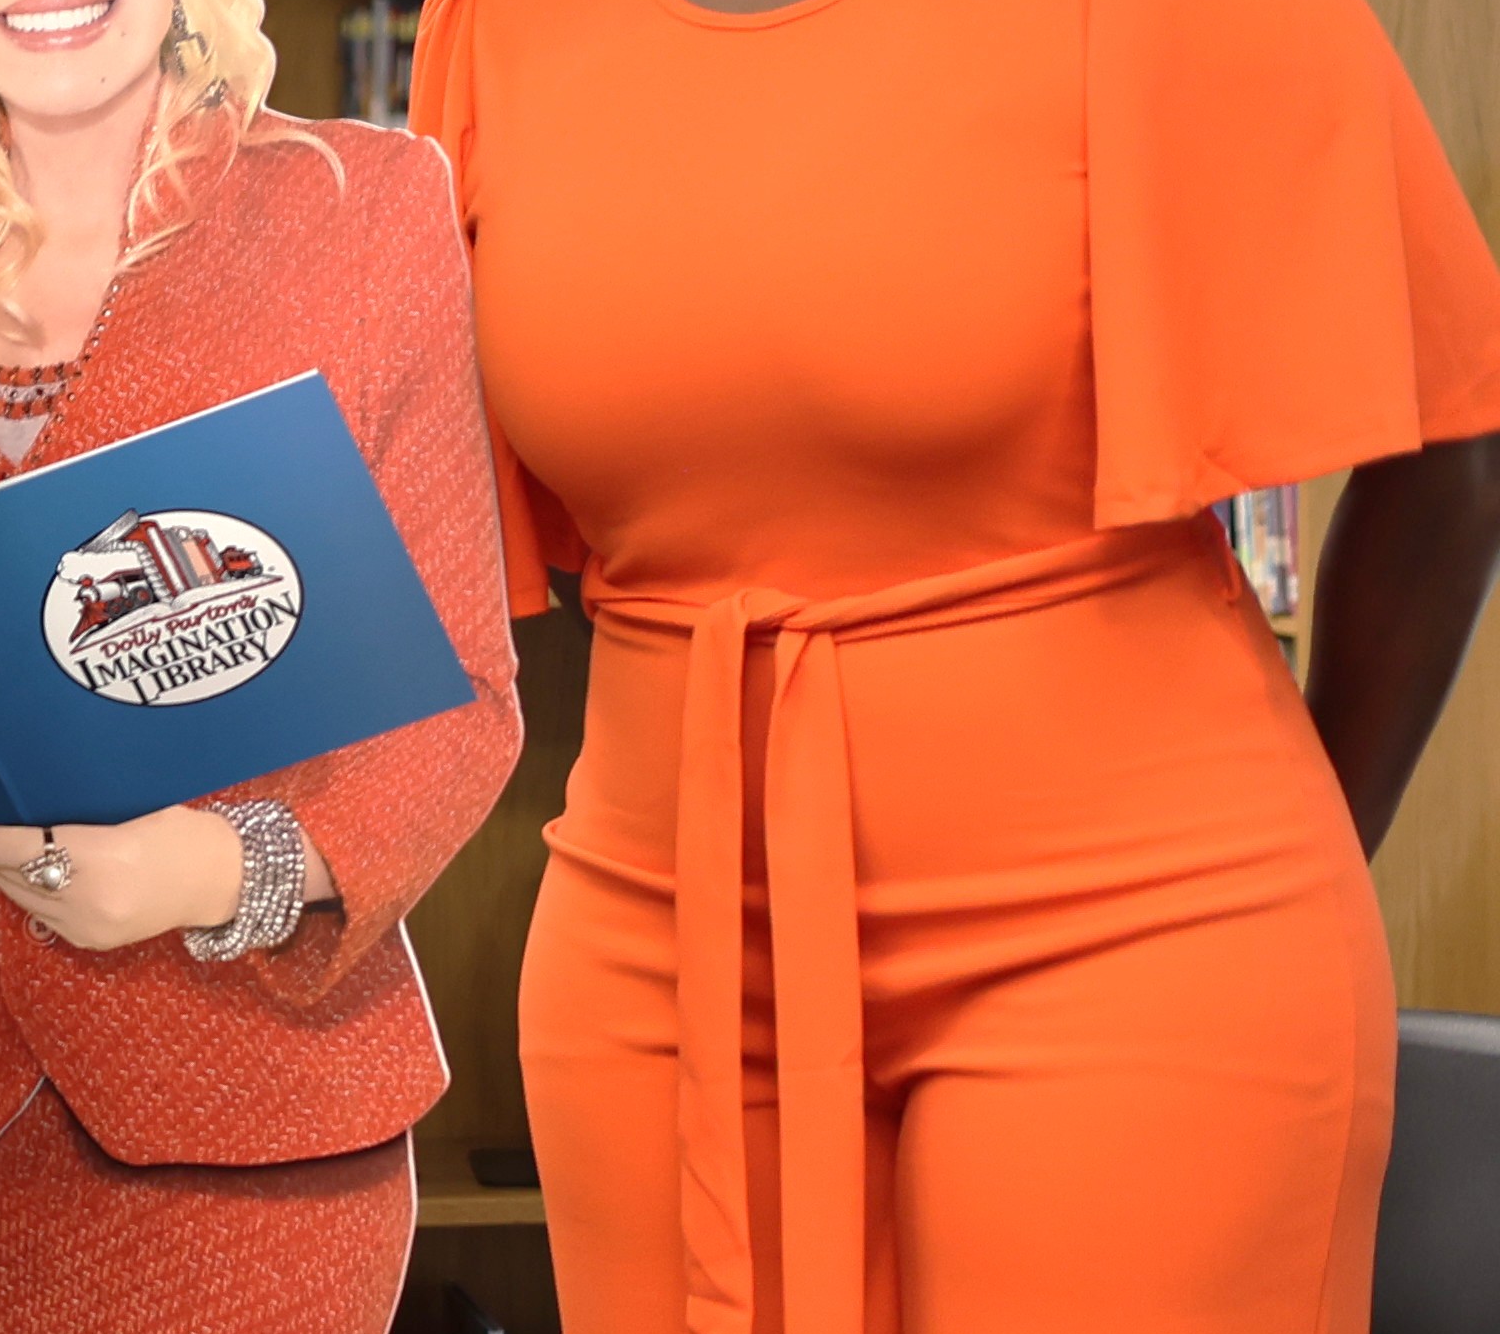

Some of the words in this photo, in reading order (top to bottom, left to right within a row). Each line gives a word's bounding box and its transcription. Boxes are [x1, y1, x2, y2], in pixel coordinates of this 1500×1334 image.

[75, 591, 300, 692] IMAGINATION
[99, 625, 162, 659] Dolly
[165, 594, 260, 636] Parton's
[129, 631, 273, 706] LIBRARY
